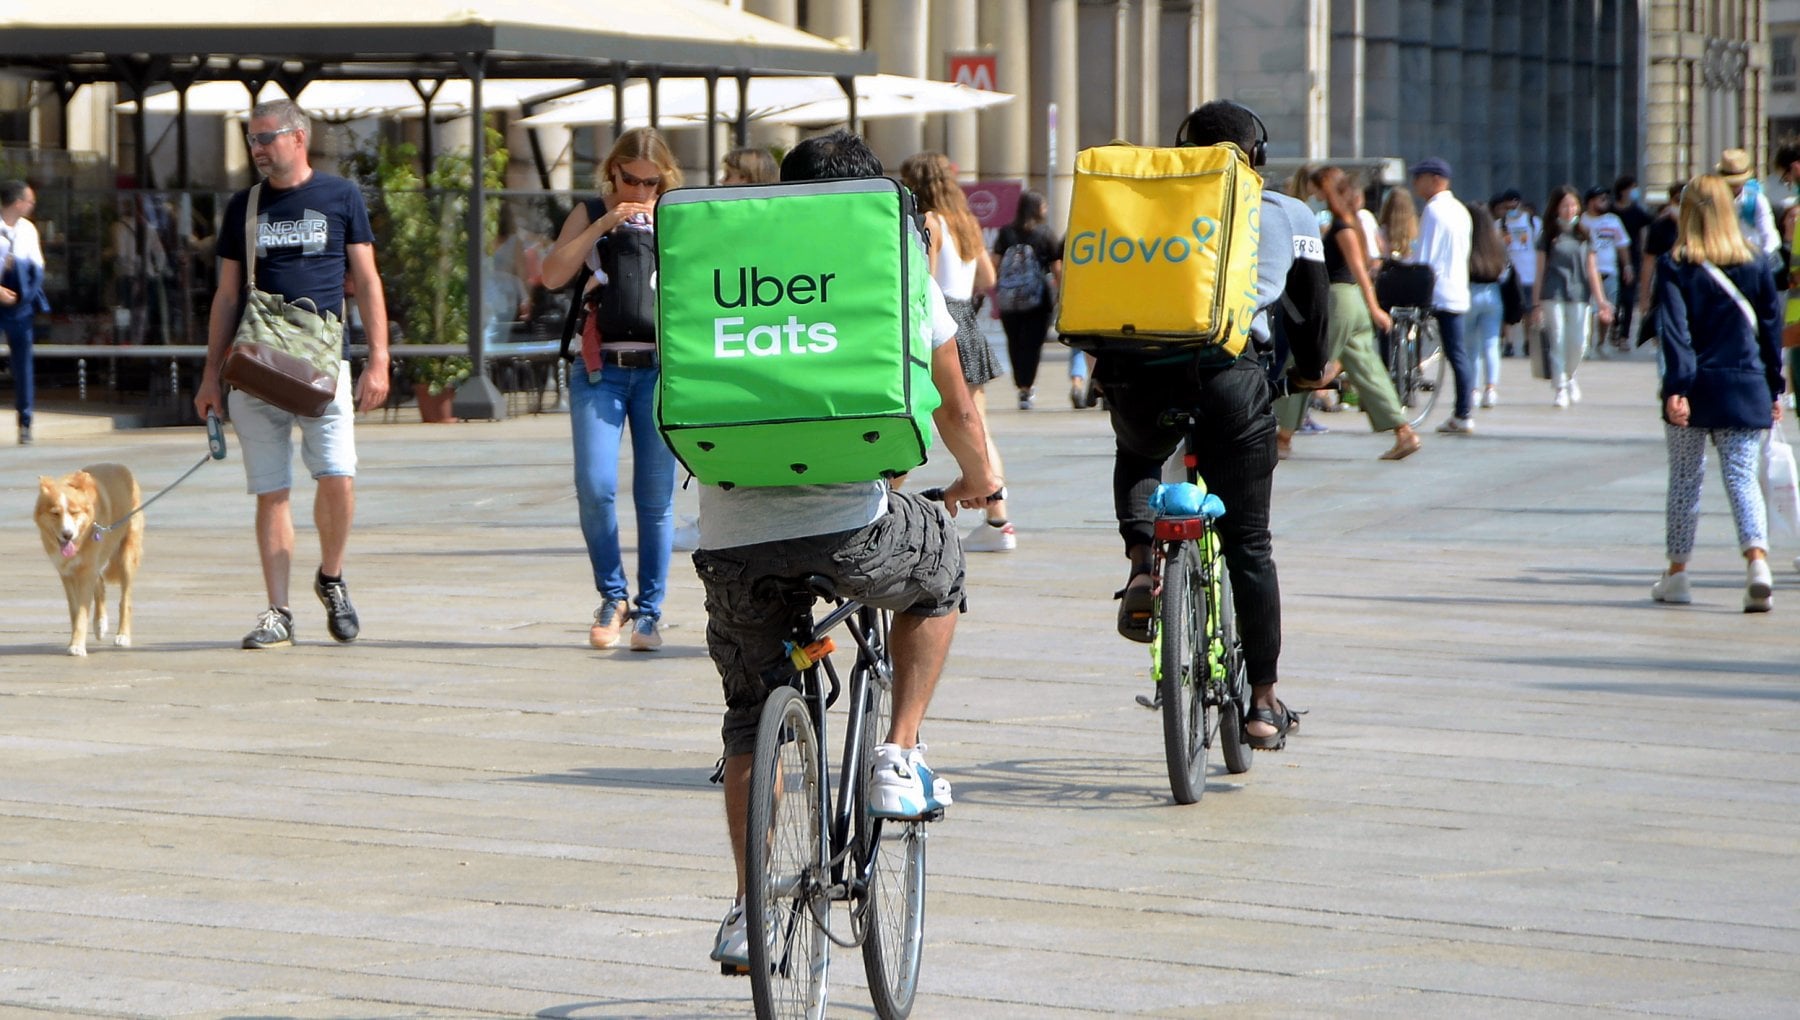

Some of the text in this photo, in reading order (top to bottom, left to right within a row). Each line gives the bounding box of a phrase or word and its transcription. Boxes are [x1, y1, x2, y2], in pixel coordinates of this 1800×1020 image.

[955, 64, 994, 91] M
[256, 220, 328, 235] NDER
[1070, 228, 1191, 265] Glovo
[713, 266, 836, 309] Uber
[714, 315, 838, 358] Eats
